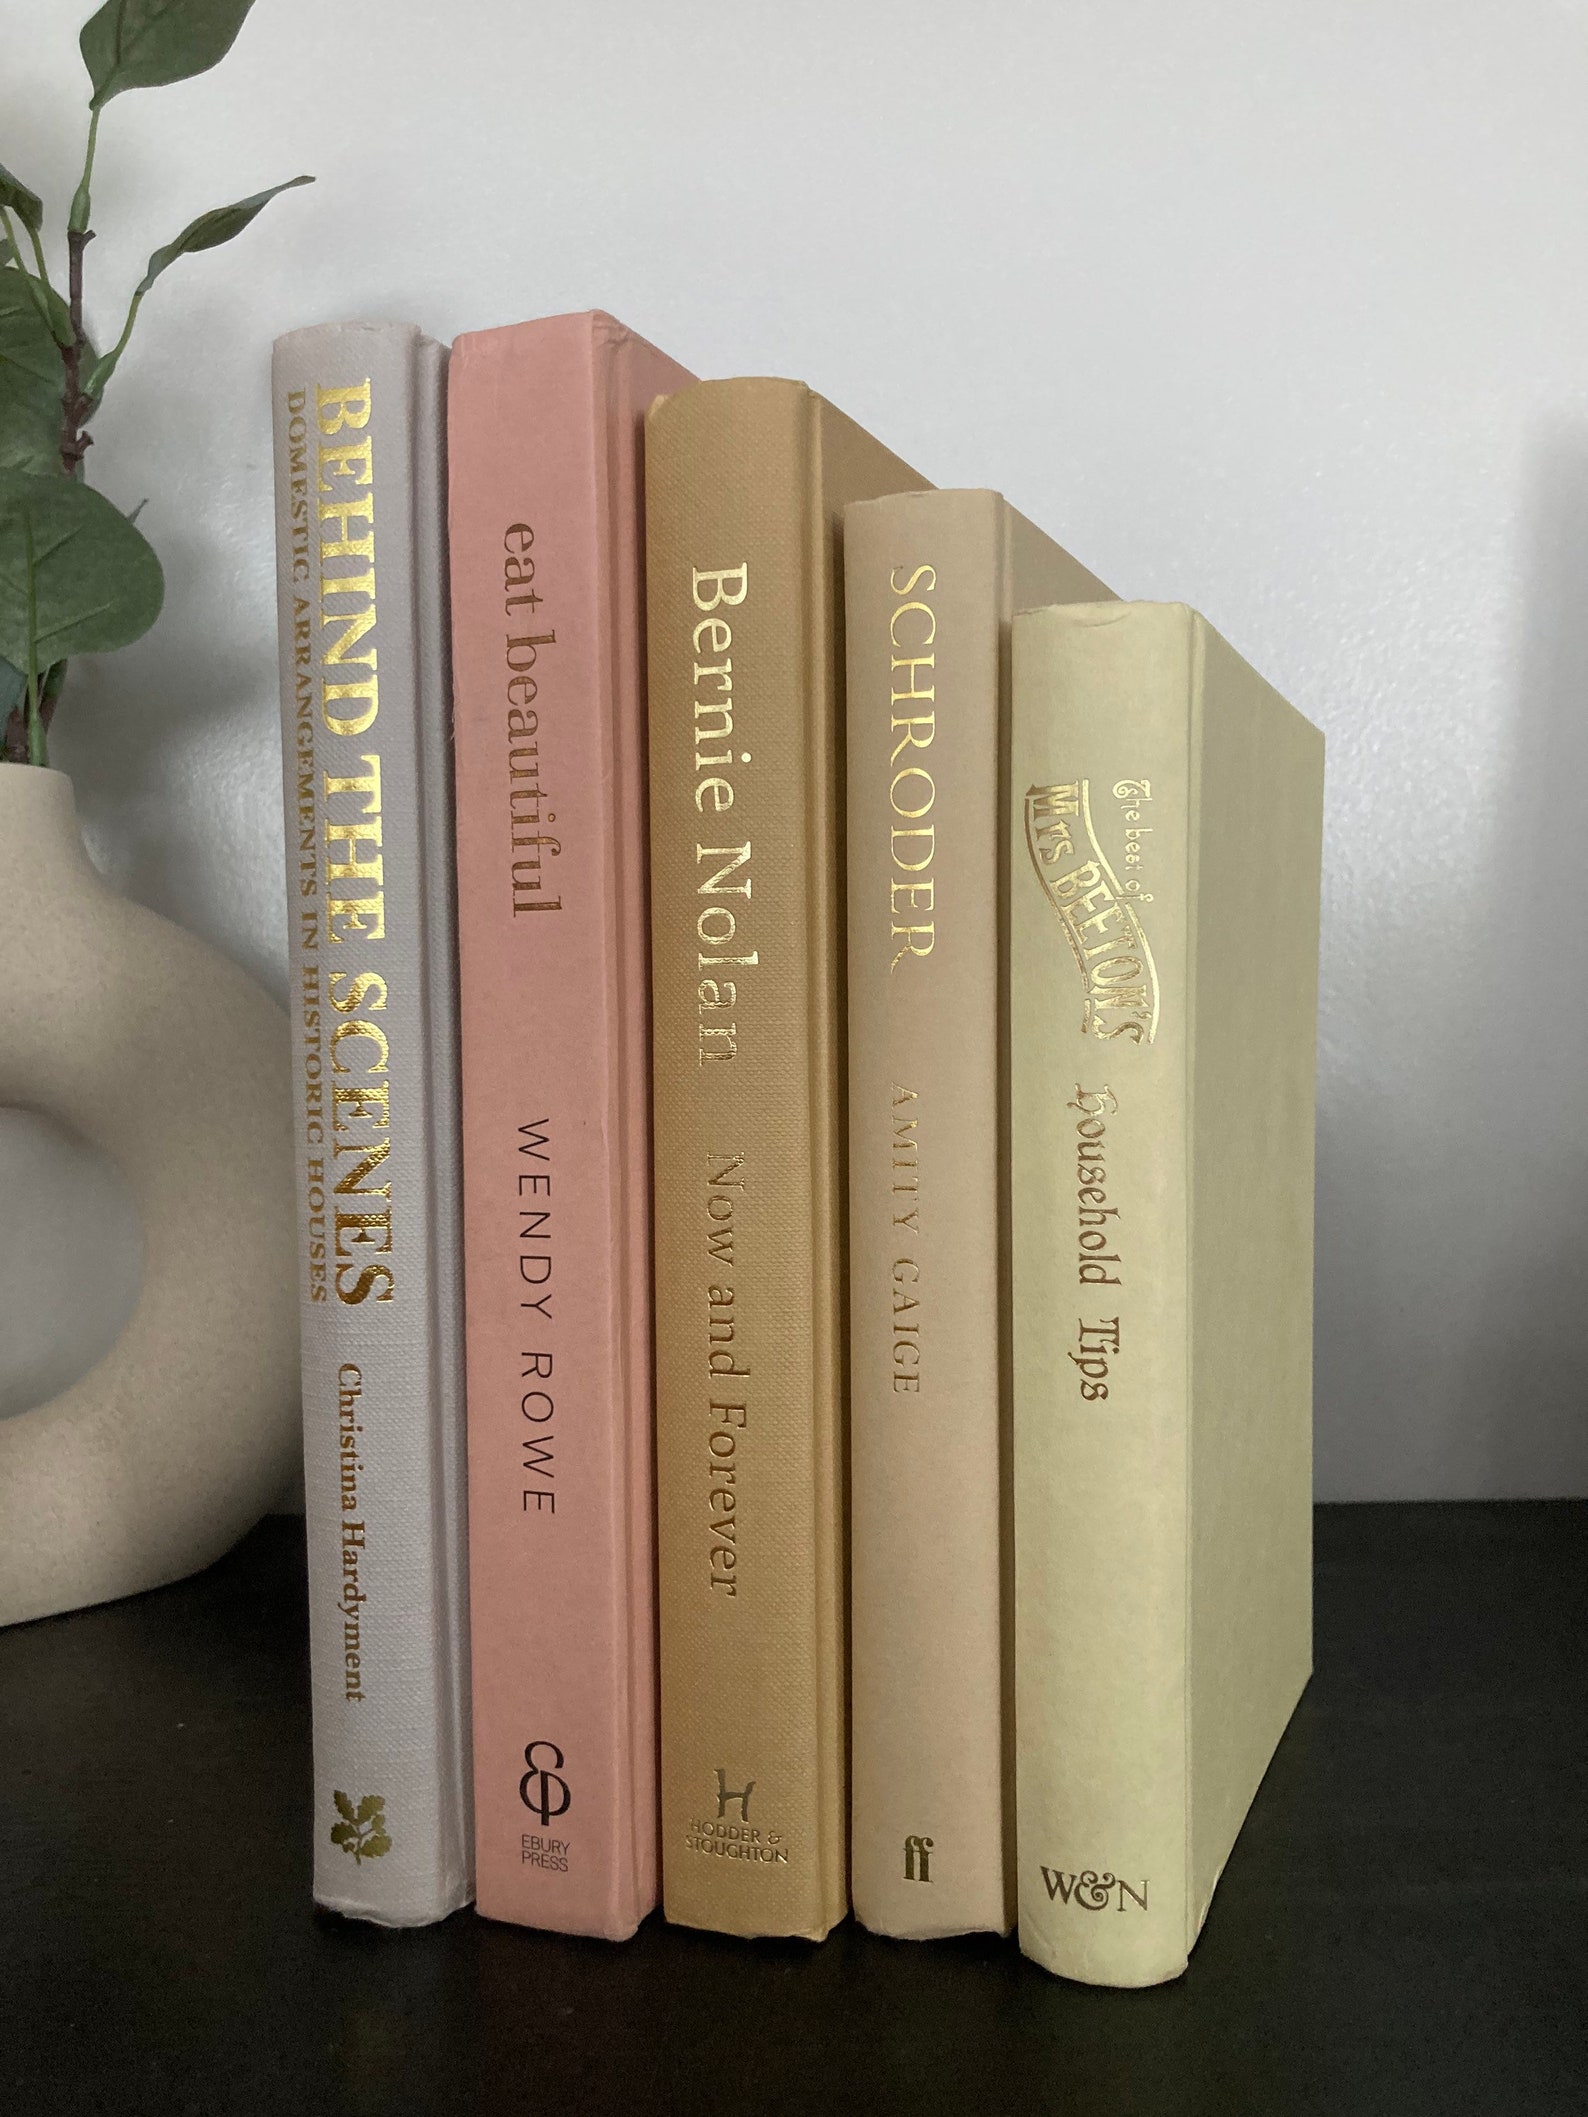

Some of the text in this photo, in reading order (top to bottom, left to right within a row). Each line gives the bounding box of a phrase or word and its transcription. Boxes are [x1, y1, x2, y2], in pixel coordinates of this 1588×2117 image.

[287, 386, 327, 1303] DOMESTIC ARRANGEMENTS IN HISTORIC HOUSES
[316, 377, 395, 1306] BEHIND THE SCENES
[504, 523, 563, 918] eat beautiful
[692, 562, 759, 1067] Bernie Nolan
[889, 564, 937, 976] SCHRODER
[1024, 779, 1080, 866] Mrs
[1112, 778, 1155, 903] The best of
[517, 1117, 556, 1515] WENDY ROWE
[706, 1151, 751, 1599] Now and Forever
[891, 1080, 921, 1394] AMITY GAIGE
[1066, 1082, 1122, 1402] Household Tips
[338, 1362, 367, 1703] Christina Hardyment
[521, 1833, 571, 1857] EBURY
[521, 1850, 569, 1873] PRESS
[685, 1834, 789, 1864] STOUGHTON
[689, 1818, 762, 1845] HODDER
[1039, 1865, 1150, 1912] W&N
